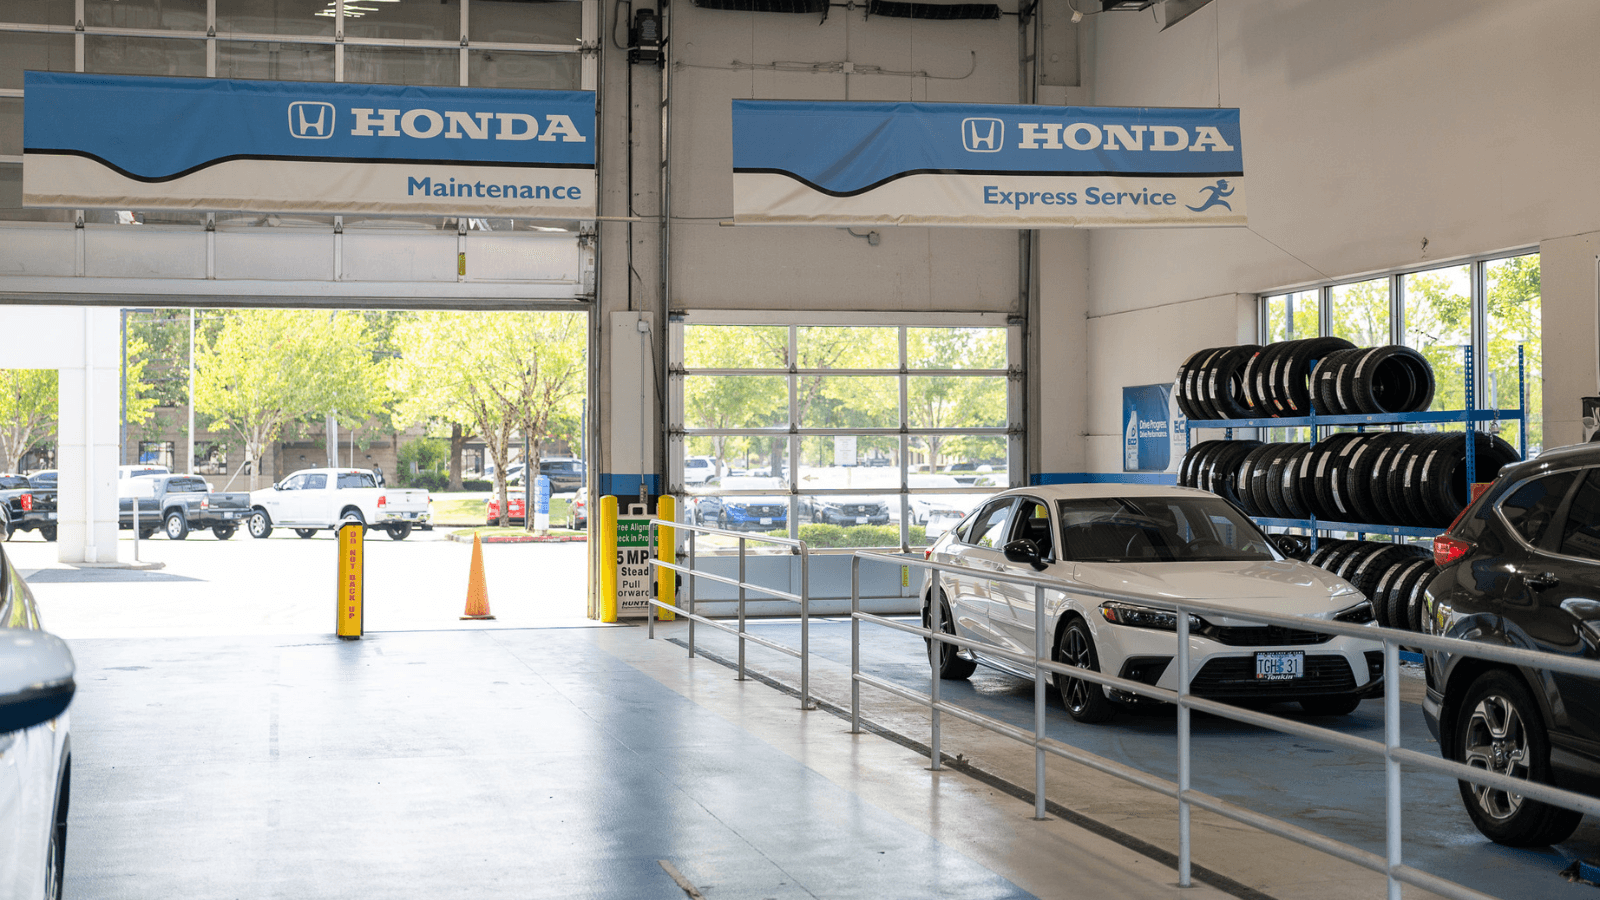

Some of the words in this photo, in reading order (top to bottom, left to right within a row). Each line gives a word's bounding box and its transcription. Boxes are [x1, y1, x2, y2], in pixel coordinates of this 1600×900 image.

[351, 108, 586, 142] HONDA
[1018, 122, 1234, 152] HONDA
[407, 176, 582, 200] Maintenance
[983, 185, 1078, 210] Express
[1085, 186, 1177, 206] Service
[1173, 420, 1186, 434] EC
[630, 523, 658, 534] Align
[617, 533, 630, 543] eck
[630, 534, 637, 542] in
[617, 550, 625, 565] 5
[621, 566, 650, 576] Stead
[622, 580, 640, 588] Pull
[617, 589, 649, 597] orwar
[348, 606, 355, 619] UP
